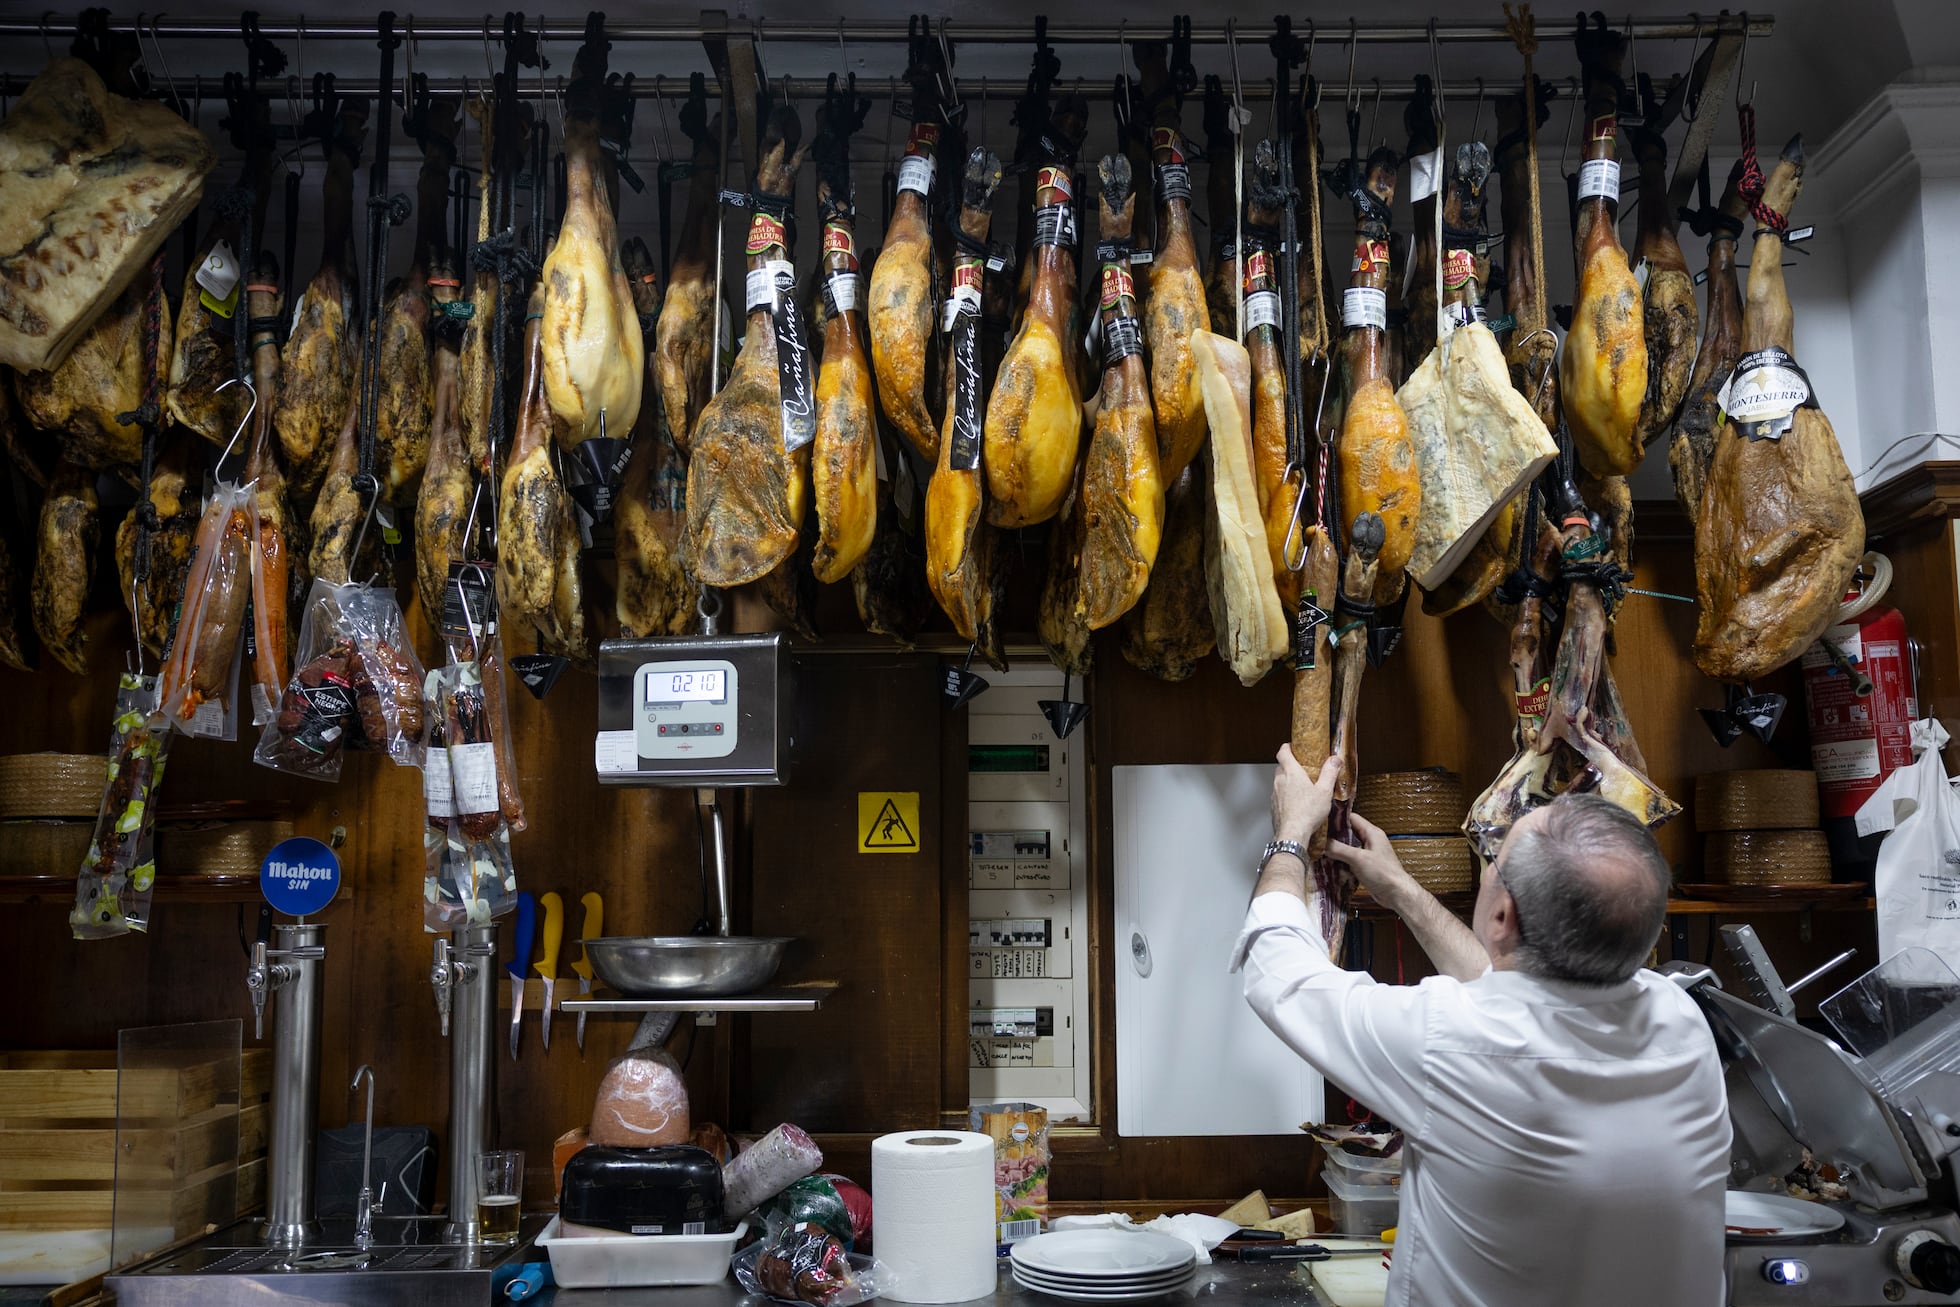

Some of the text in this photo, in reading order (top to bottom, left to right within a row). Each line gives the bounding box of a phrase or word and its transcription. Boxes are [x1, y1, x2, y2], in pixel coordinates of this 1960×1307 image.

[1728, 391, 1805, 412] MONTESIERRA
[672, 673, 716, 693] 0.210
[315, 690, 348, 710] ESTIRPE
[268, 861, 332, 881] Mahou
[287, 879, 310, 891] SIN
